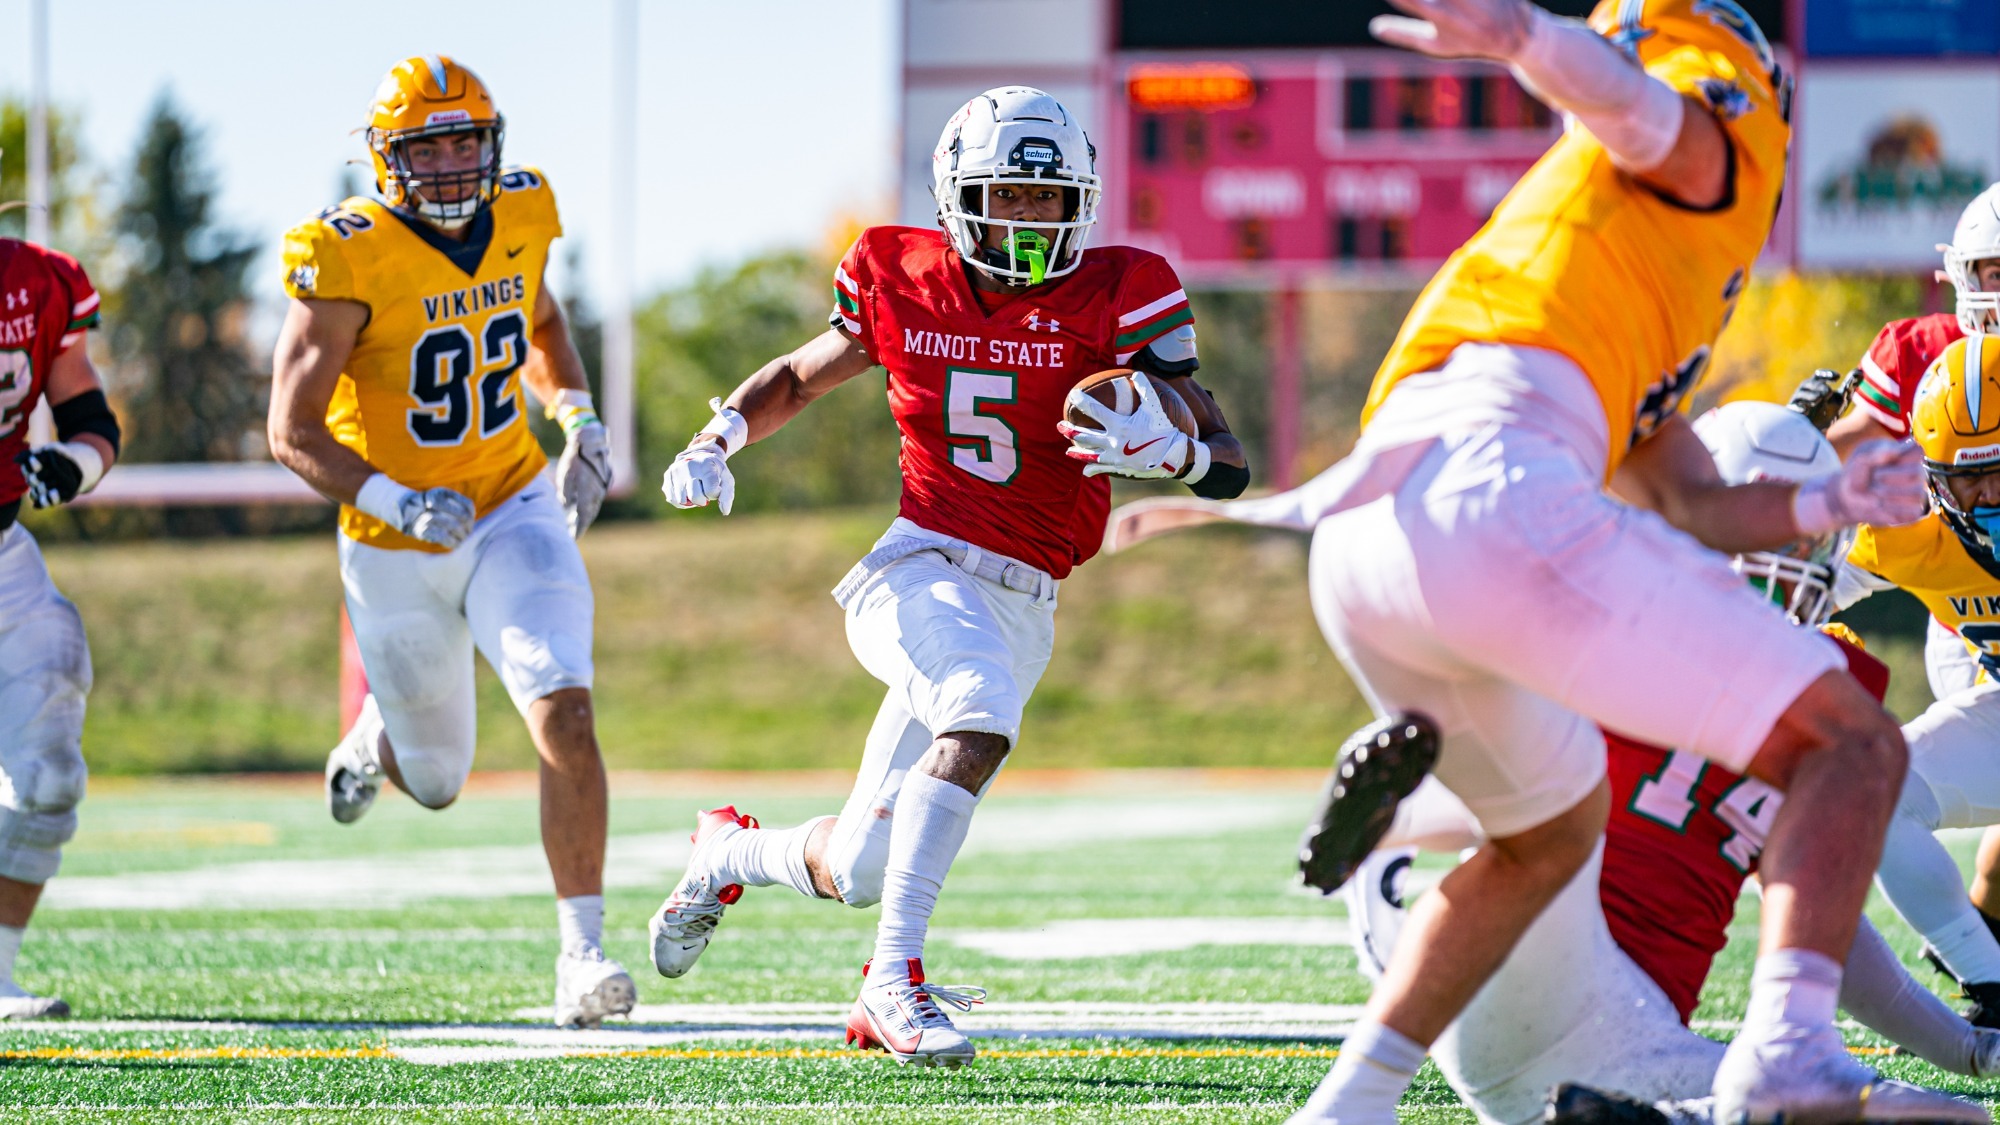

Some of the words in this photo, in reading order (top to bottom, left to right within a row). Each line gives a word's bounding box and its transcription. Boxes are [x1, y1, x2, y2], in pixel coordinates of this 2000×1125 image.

[1025, 150, 1052, 159] schutt
[423, 274, 525, 323] VIKINGS
[406, 308, 530, 447] 92
[904, 328, 981, 362] MINOT
[989, 339, 1064, 368] STATE
[943, 366, 1022, 487] 5
[1627, 748, 1785, 875] 14
